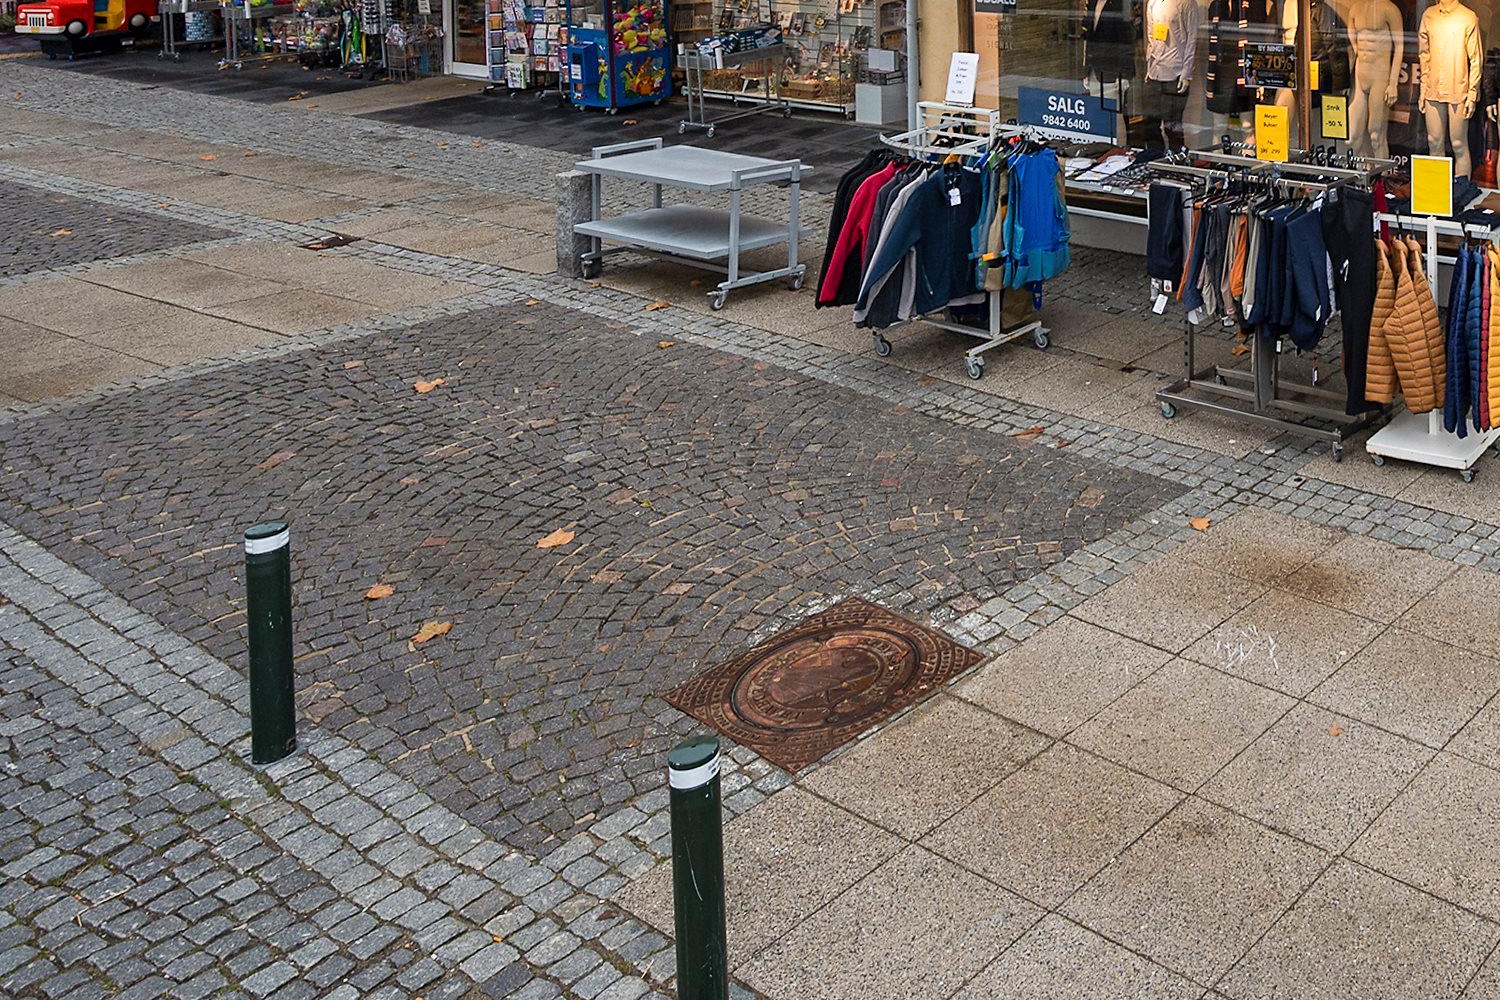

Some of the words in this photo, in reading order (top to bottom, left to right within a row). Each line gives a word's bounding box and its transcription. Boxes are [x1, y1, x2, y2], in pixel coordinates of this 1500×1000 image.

[1265, 55, 1293, 70] 70%
[1048, 95, 1085, 115] SALG
[1042, 114, 1066, 127] 9842
[1067, 118, 1091, 131] 6400
